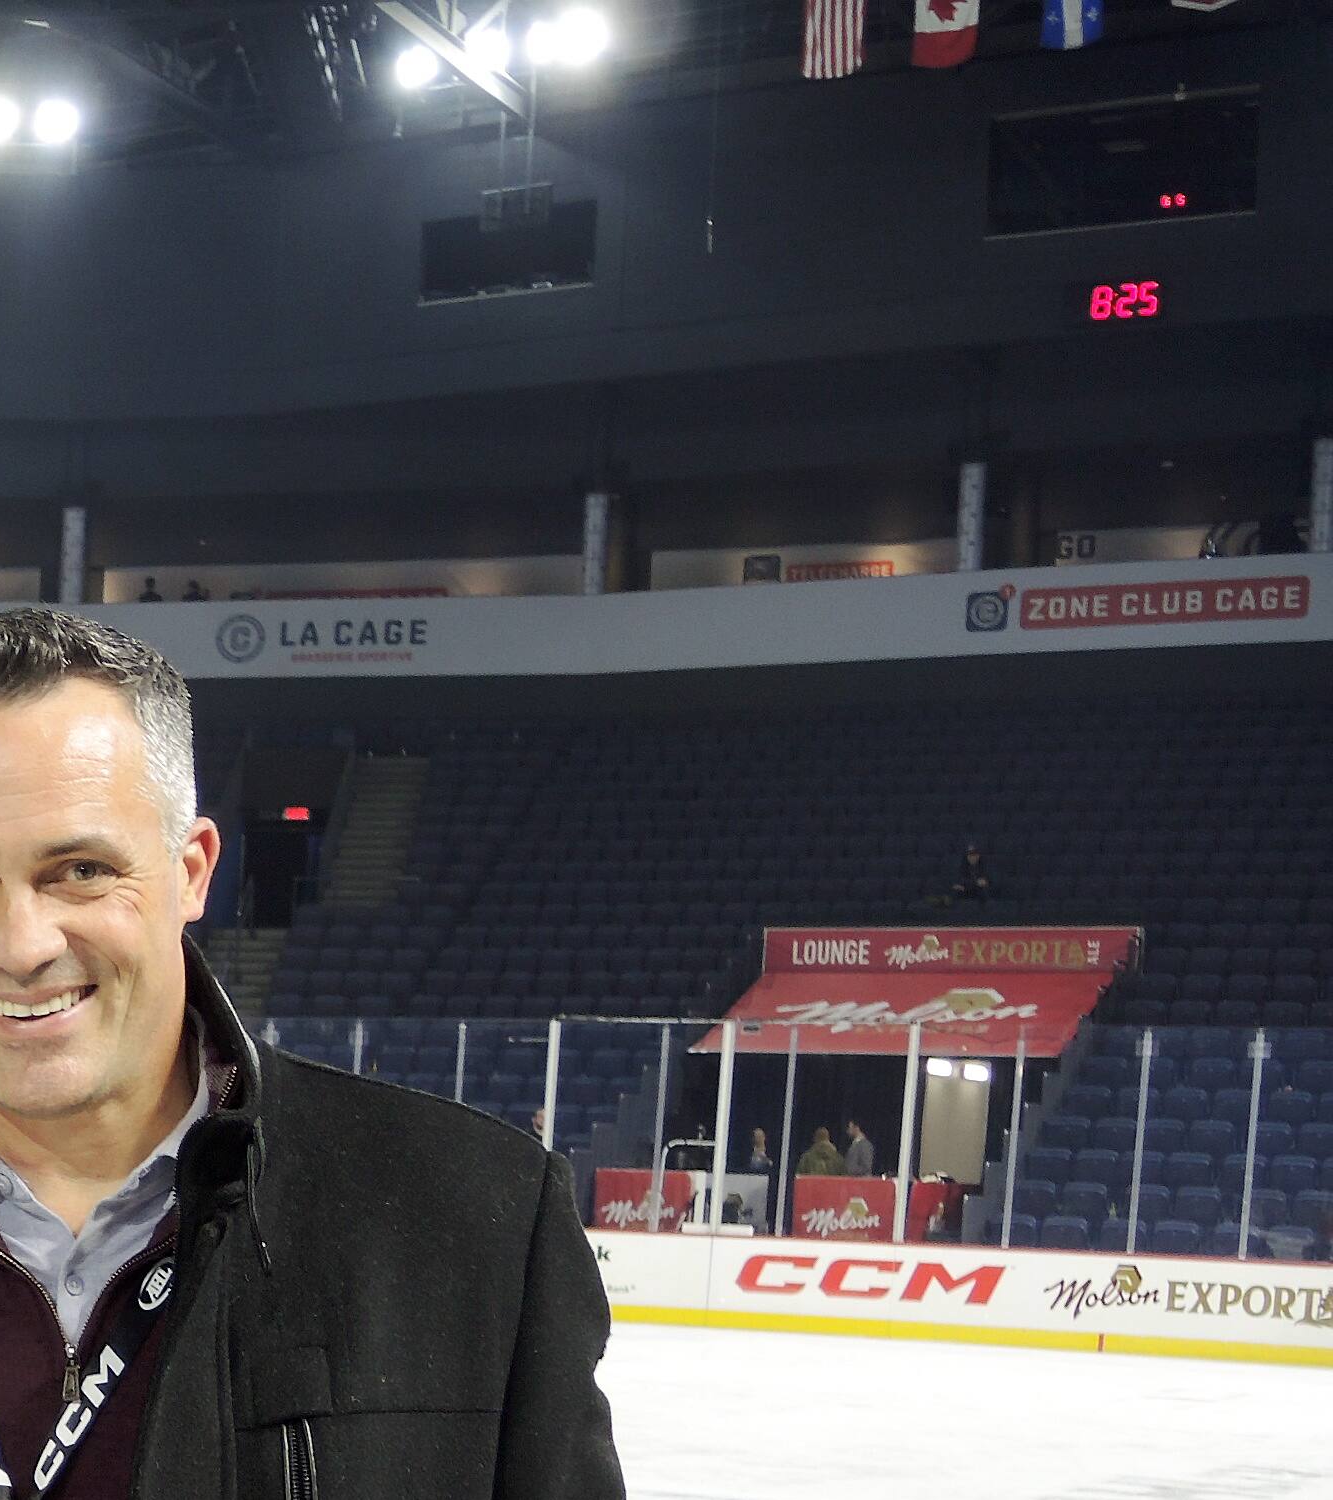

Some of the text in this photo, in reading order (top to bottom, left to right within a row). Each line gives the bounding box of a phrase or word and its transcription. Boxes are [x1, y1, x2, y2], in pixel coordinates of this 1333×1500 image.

[1028, 586, 1302, 622] ZONE CLUB CAGE
[279, 619, 428, 646] LA CAGE
[792, 938, 871, 966] LOUNGE
[802, 1208, 880, 1237] Molson
[735, 1253, 1005, 1306] CCM
[1043, 1277, 1160, 1320] Molson
[1165, 1278, 1324, 1322] EXPORT
[34, 1344, 126, 1491] CCM
